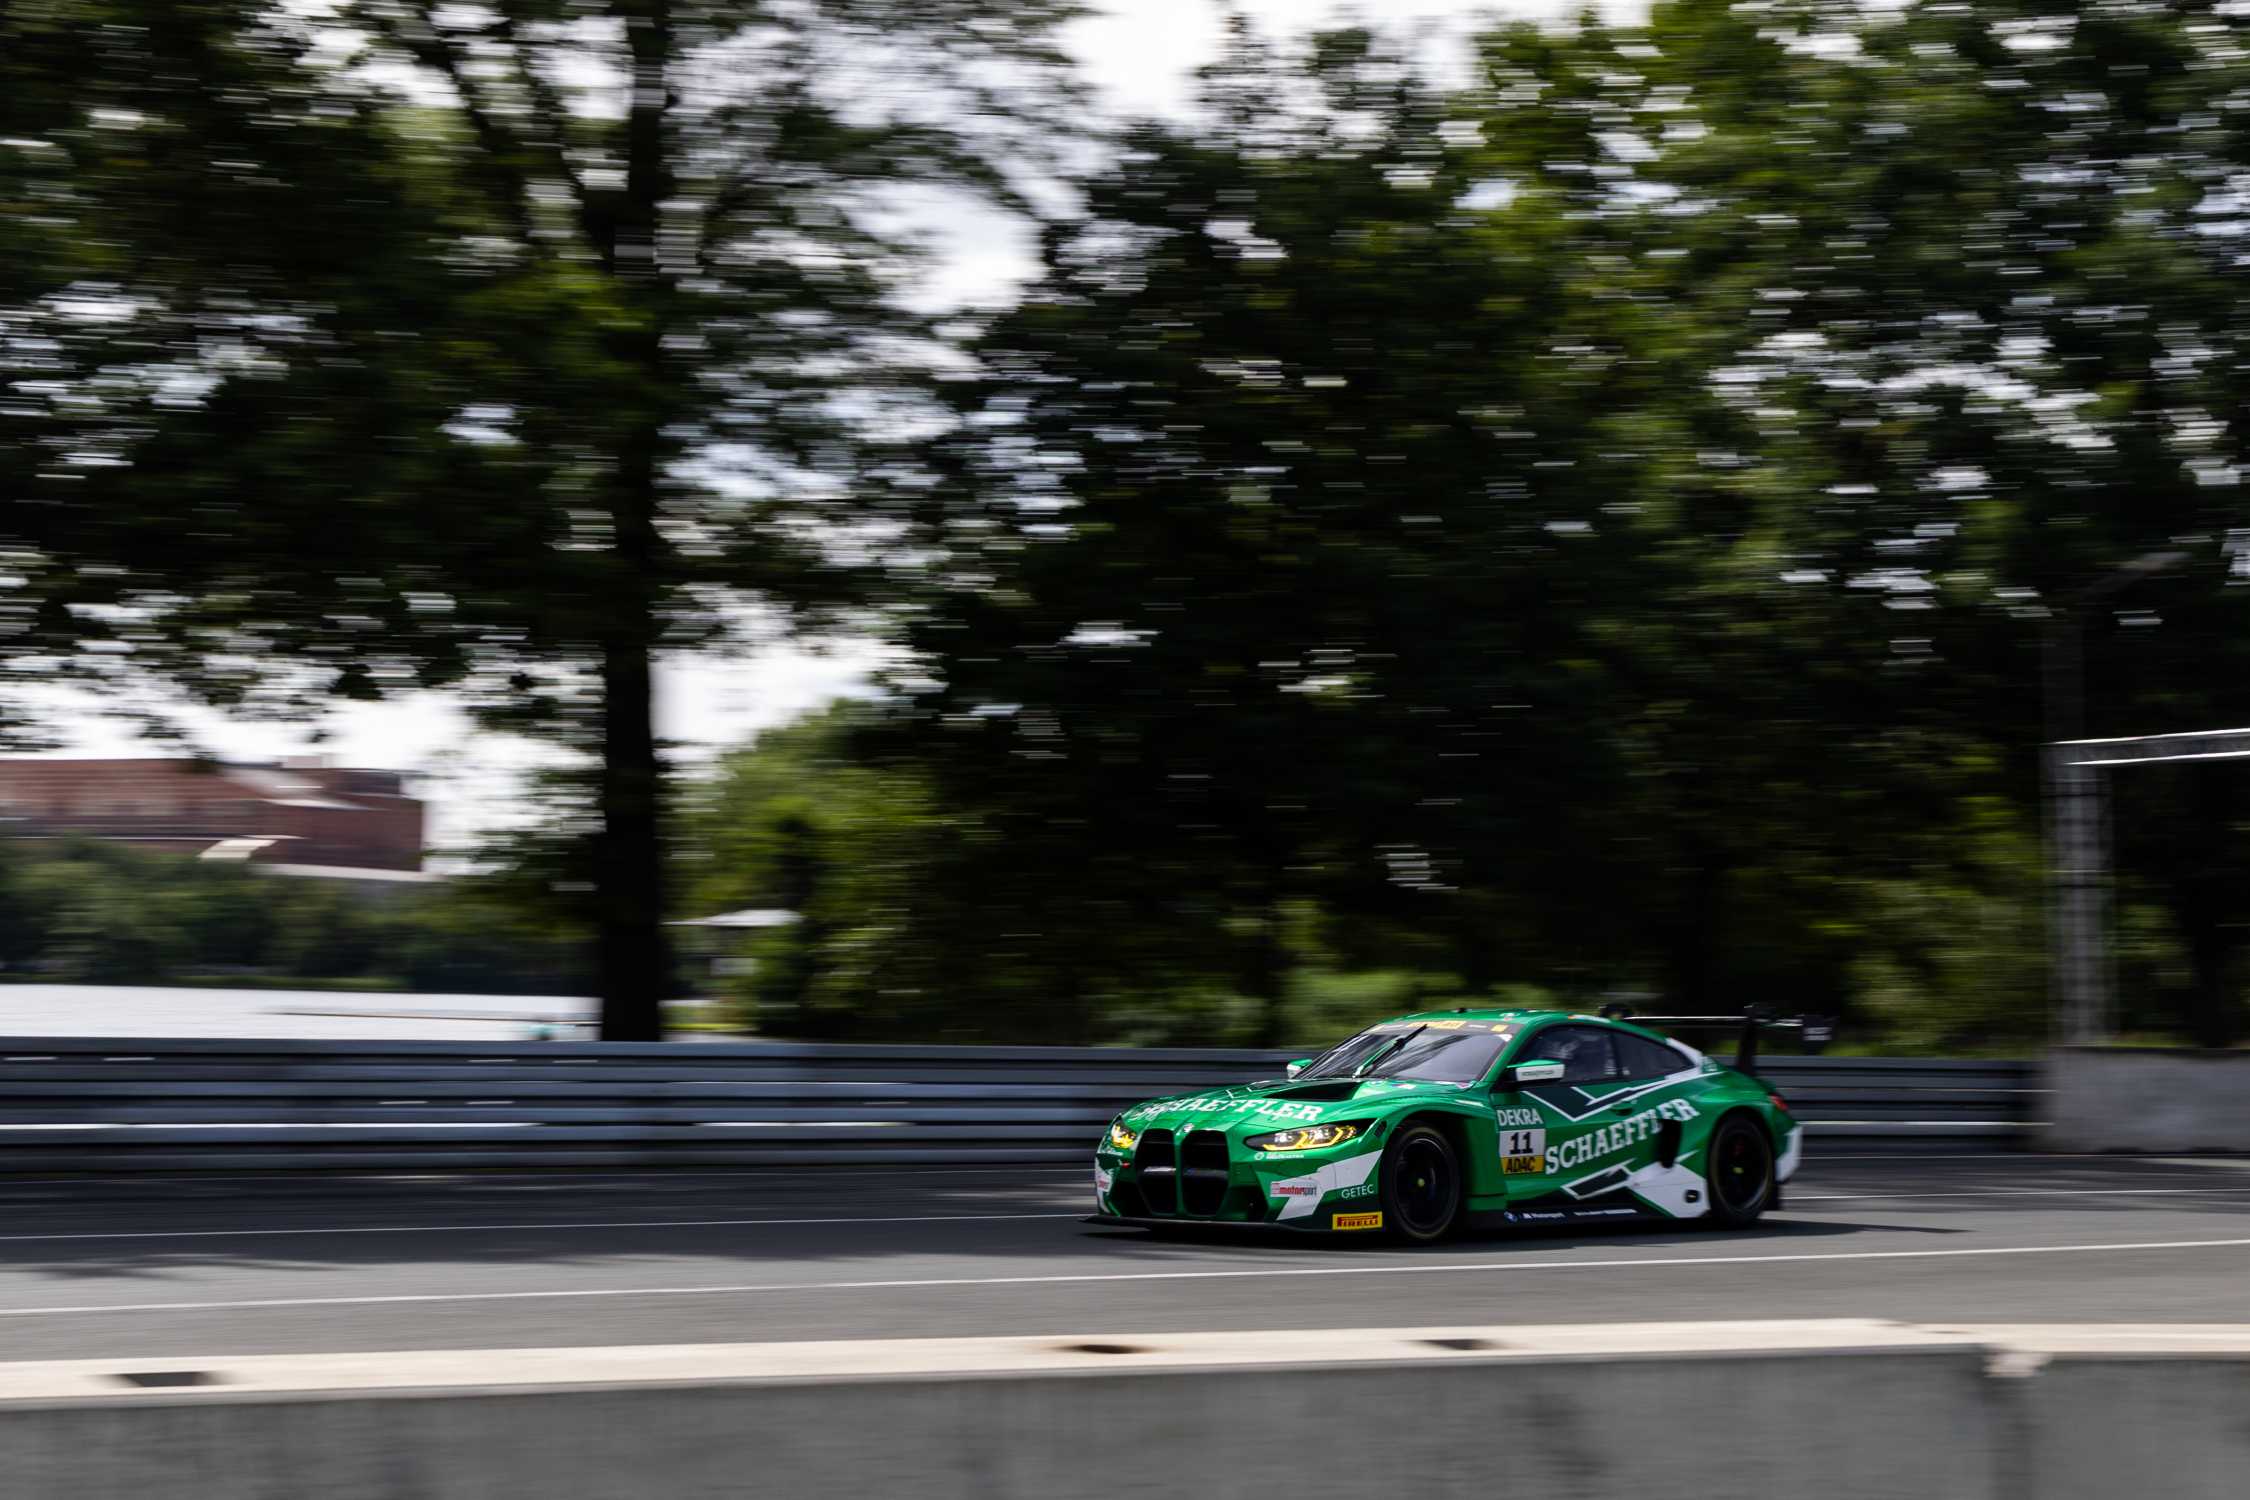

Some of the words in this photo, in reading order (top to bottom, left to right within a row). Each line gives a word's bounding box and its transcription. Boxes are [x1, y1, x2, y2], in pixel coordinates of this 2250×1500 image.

[1496, 1107, 1544, 1127] DEKRA
[1509, 1131, 1534, 1155] 11
[1545, 1098, 1700, 1175] SCHAEFFLER
[1505, 1156, 1536, 1173] ADAC
[1341, 1184, 1375, 1199] GETEC
